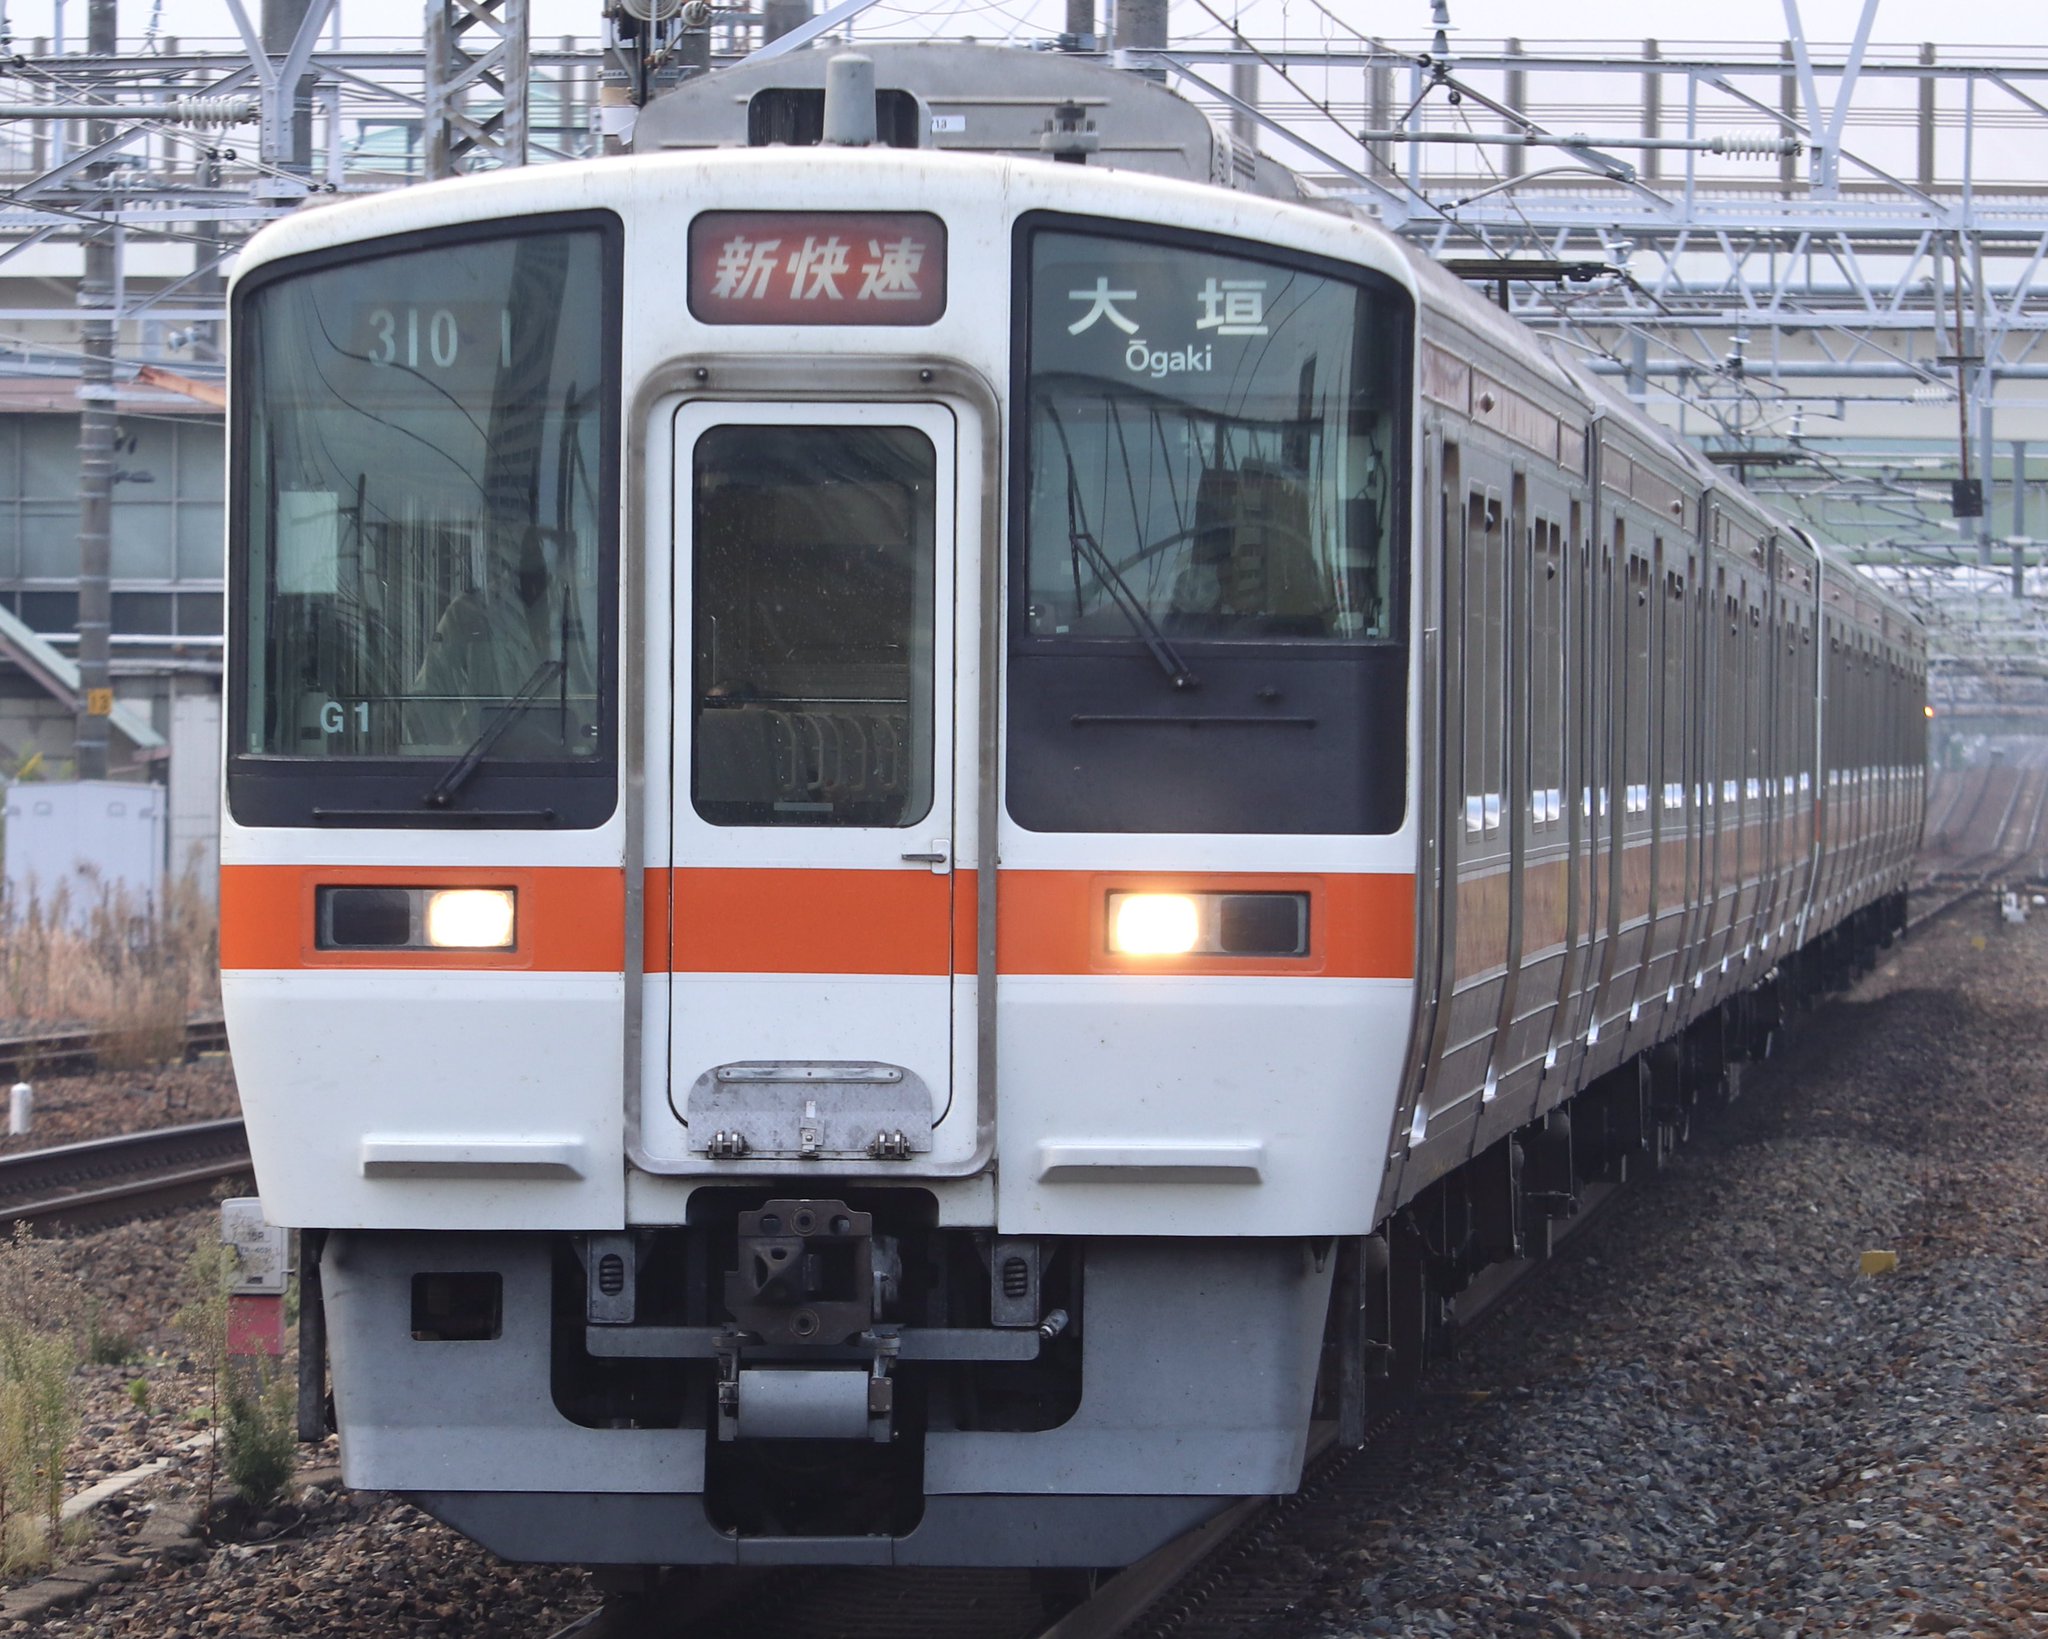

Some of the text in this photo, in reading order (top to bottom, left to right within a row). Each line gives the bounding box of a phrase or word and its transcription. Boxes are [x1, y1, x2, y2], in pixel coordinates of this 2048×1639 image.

[711, 236, 926, 299] 新快速
[1067, 277, 1268, 336] 大垣
[369, 309, 457, 367] 310
[1126, 340, 1212, 377] Ōgaki
